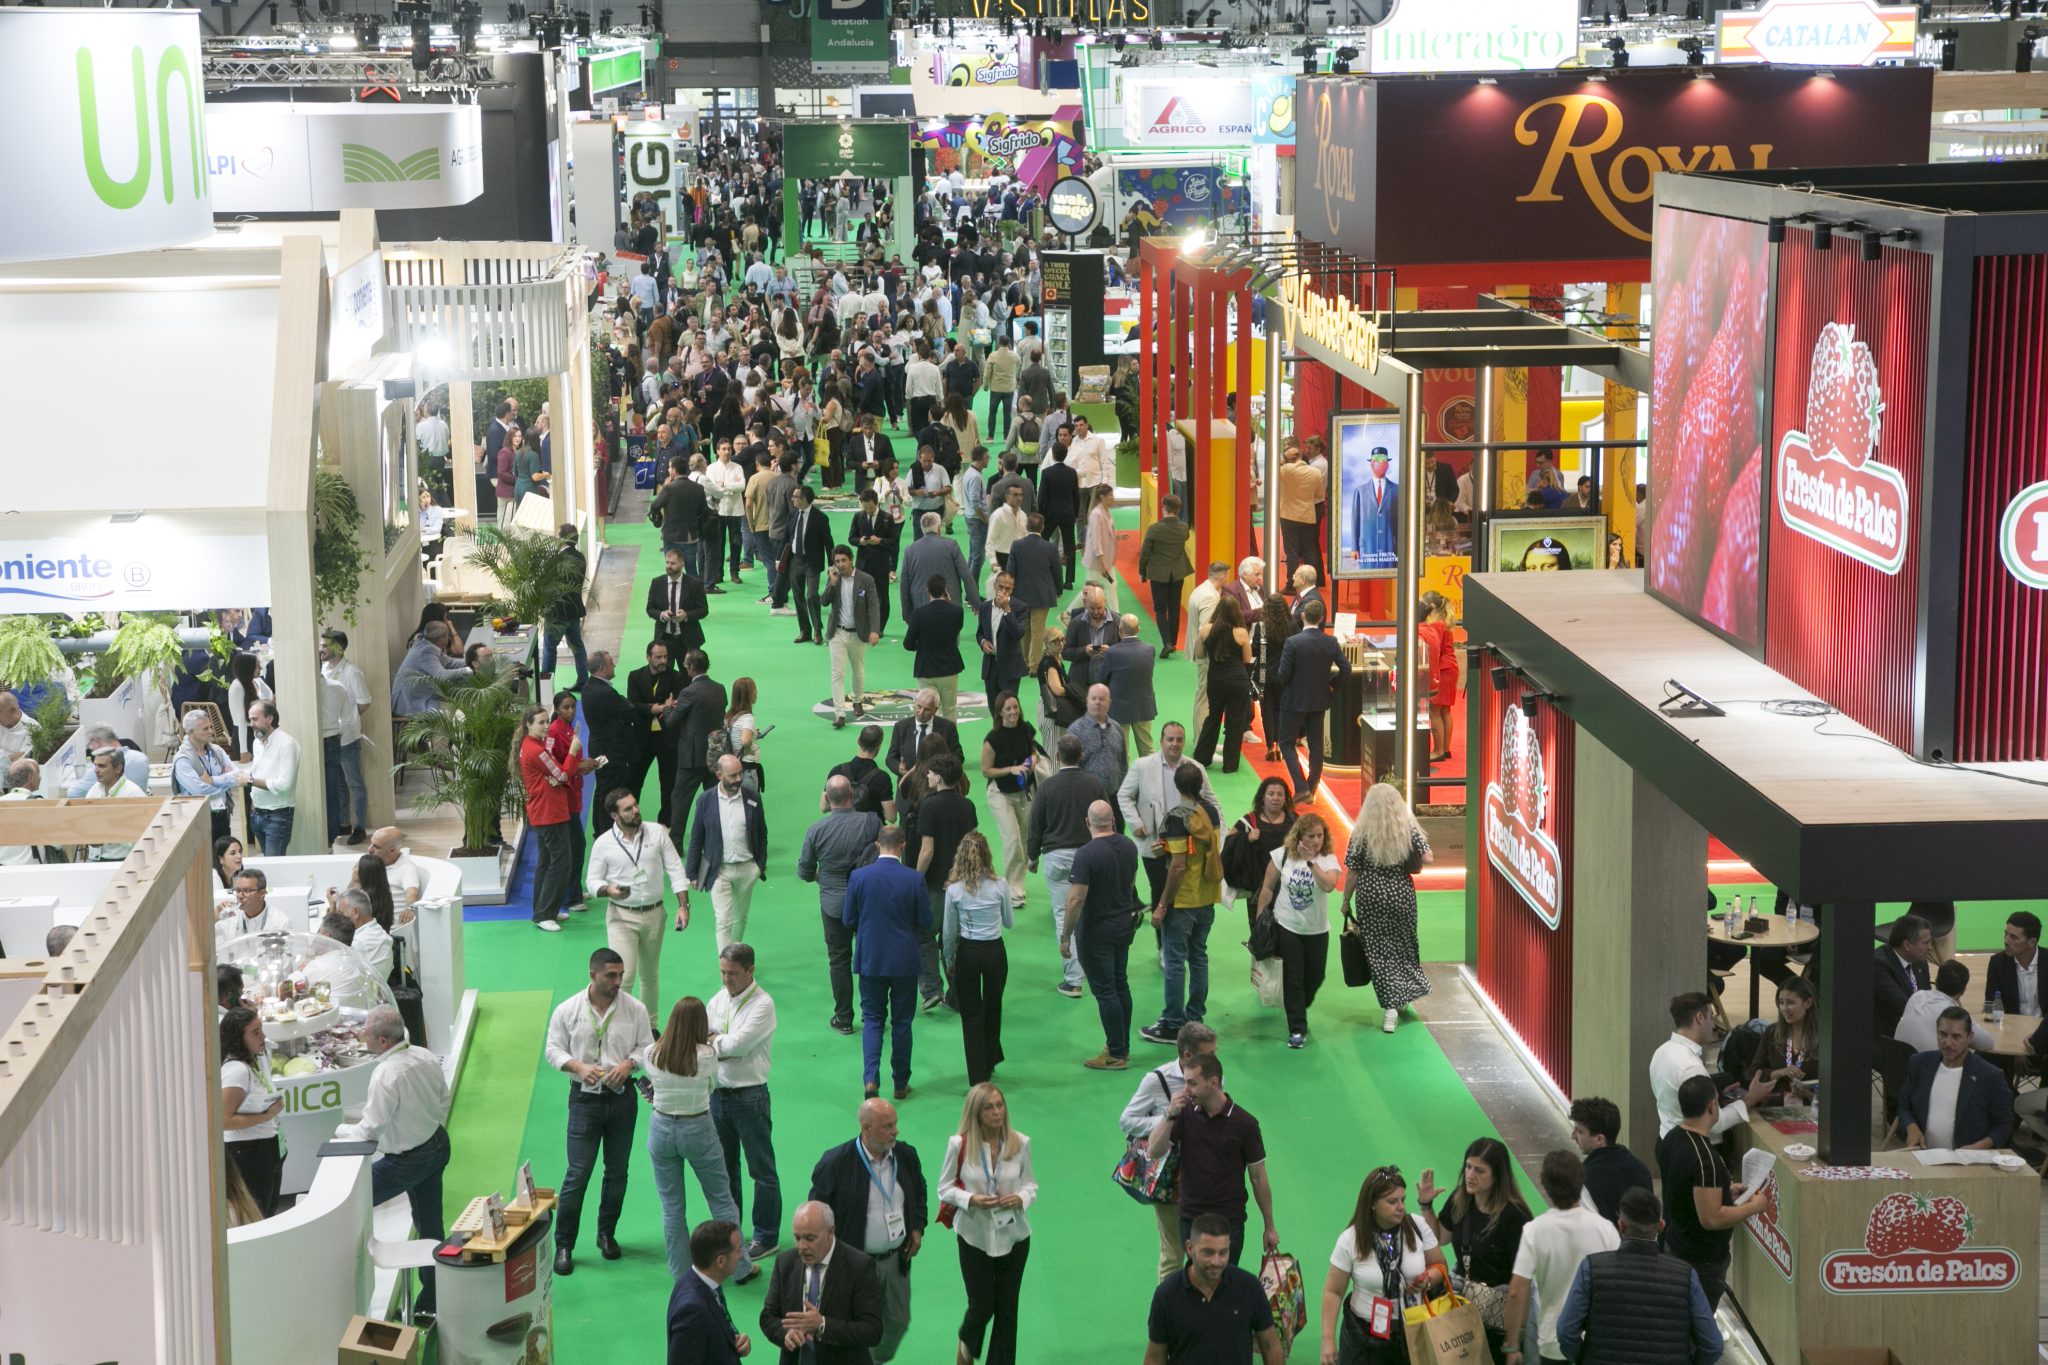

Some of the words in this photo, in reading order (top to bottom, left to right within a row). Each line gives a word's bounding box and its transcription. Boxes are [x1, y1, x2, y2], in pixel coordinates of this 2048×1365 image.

[827, 38, 875, 47] Andalucía
[1764, 22, 1874, 47] CATALAN
[1384, 26, 1564, 70] Interagro
[976, 65, 1018, 82] Sigfrido
[1148, 125, 1207, 134] AGRICO
[991, 131, 1039, 154] Sigfrido
[1052, 193, 1088, 206] wak
[1044, 280, 1071, 290] MOLE
[1785, 457, 1835, 521] Fresón
[1836, 477, 1855, 530] de
[1854, 485, 1897, 549] Palos
[0, 553, 112, 580] niente
[1489, 803, 1520, 870] Fresón
[1520, 835, 1531, 882] de
[1530, 846, 1556, 909] Palos
[1771, 1231, 1791, 1272] Palos
[1833, 1260, 1915, 1284] Fresón
[1916, 1259, 1944, 1282] de
[1945, 1258, 2008, 1282] Palos
